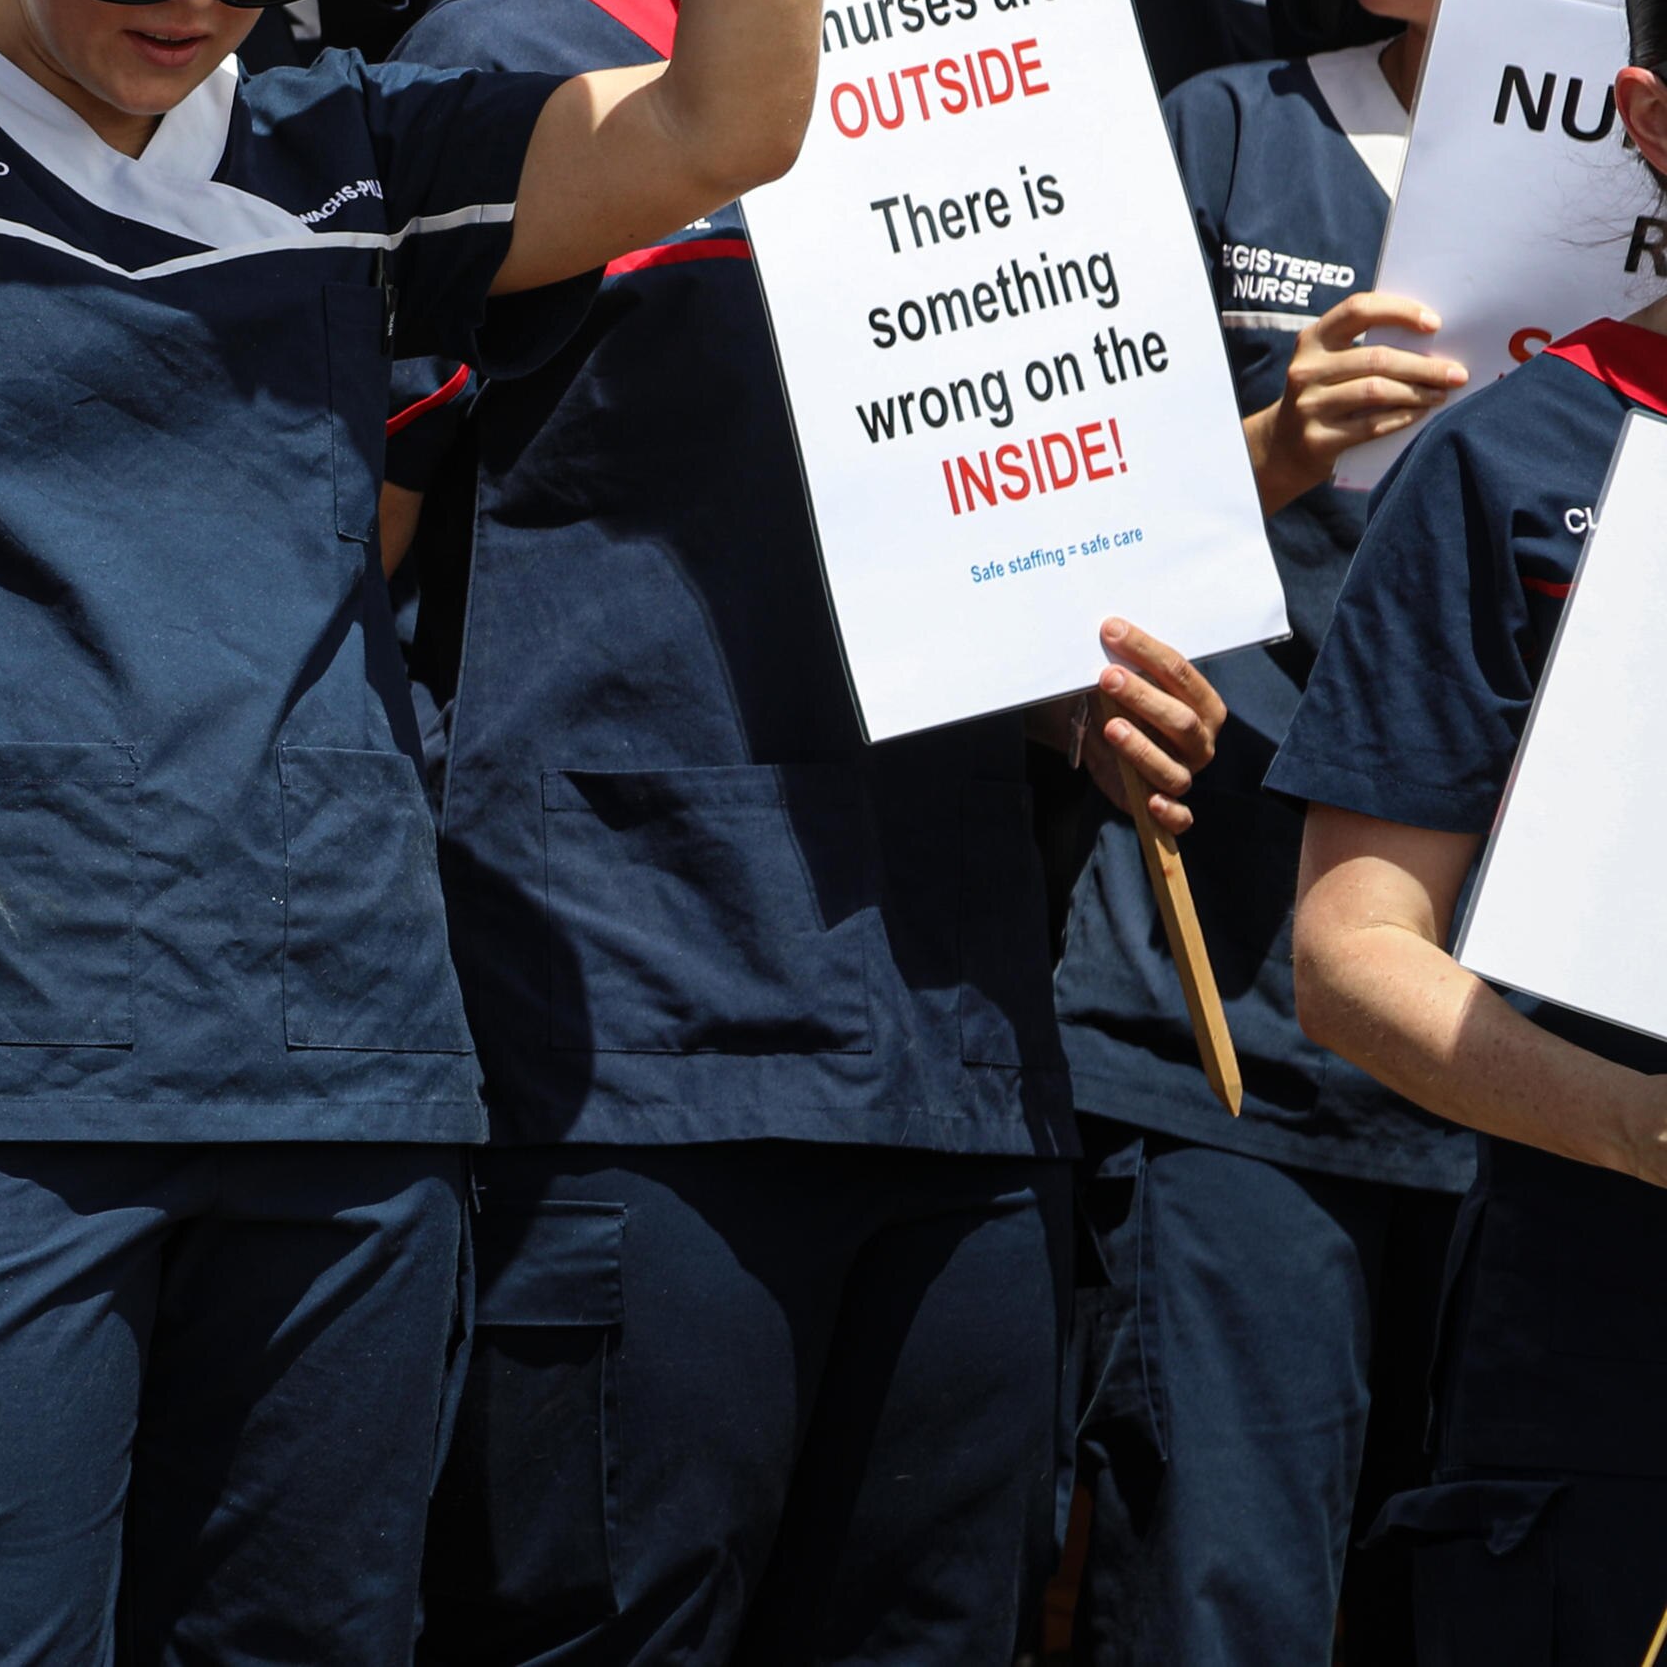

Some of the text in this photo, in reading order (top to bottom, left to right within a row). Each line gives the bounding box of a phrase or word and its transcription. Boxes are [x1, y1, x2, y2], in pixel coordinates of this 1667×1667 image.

[829, 37, 1051, 140] OUTSIDE
[870, 165, 1066, 254] There is
[867, 249, 1117, 350] something
[1233, 274, 1313, 307] NURSE
[855, 327, 1170, 445] wrong on the
[941, 418, 1129, 517] INSIDE!
[970, 560, 1005, 584] Safe
[1008, 546, 1067, 576] staffing
[1080, 533, 1111, 557] safe
[1113, 527, 1145, 549] care
